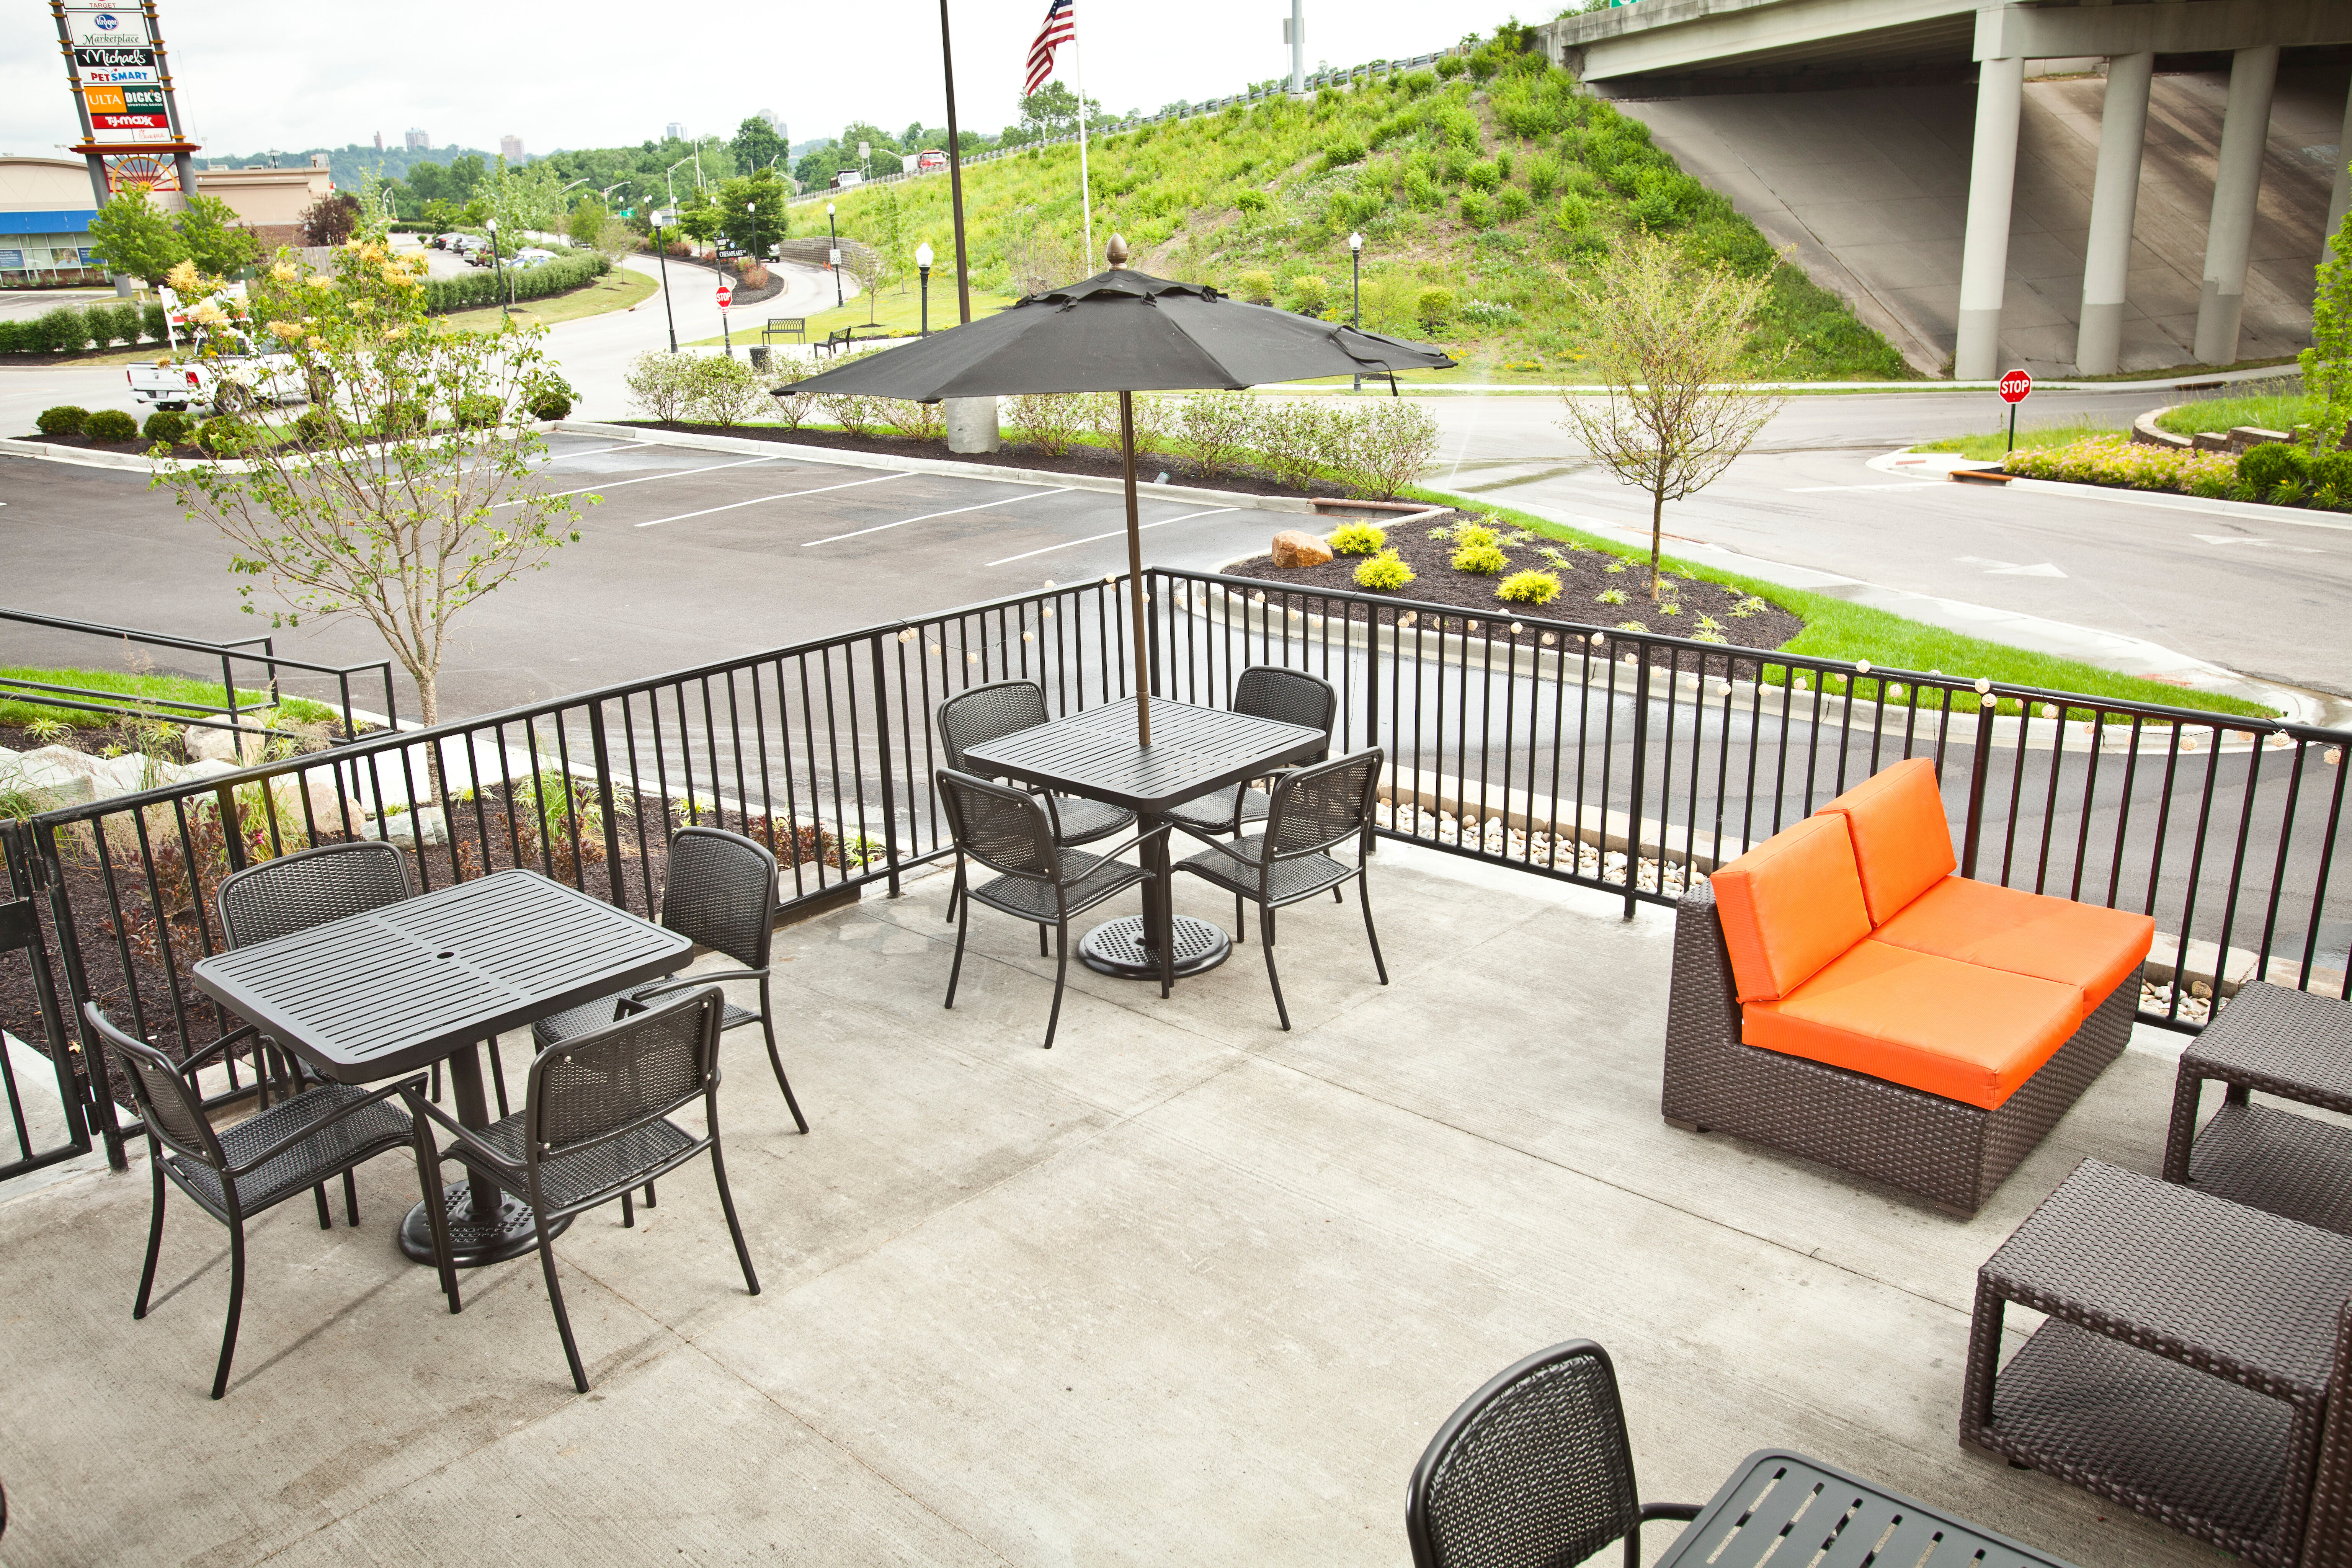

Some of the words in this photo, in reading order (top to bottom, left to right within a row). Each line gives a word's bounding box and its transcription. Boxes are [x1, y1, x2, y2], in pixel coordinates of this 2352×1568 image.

[96, 15, 117, 30] Kroger
[82, 33, 139, 45] Marketplace
[82, 49, 146, 66] Michaels
[89, 95, 122, 105] ULTA
[124, 92, 162, 103] DICK'S
[719, 250, 743, 258] CHESAPEAKE
[717, 292, 731, 302] STOP
[2001, 379, 2029, 394] STOP
